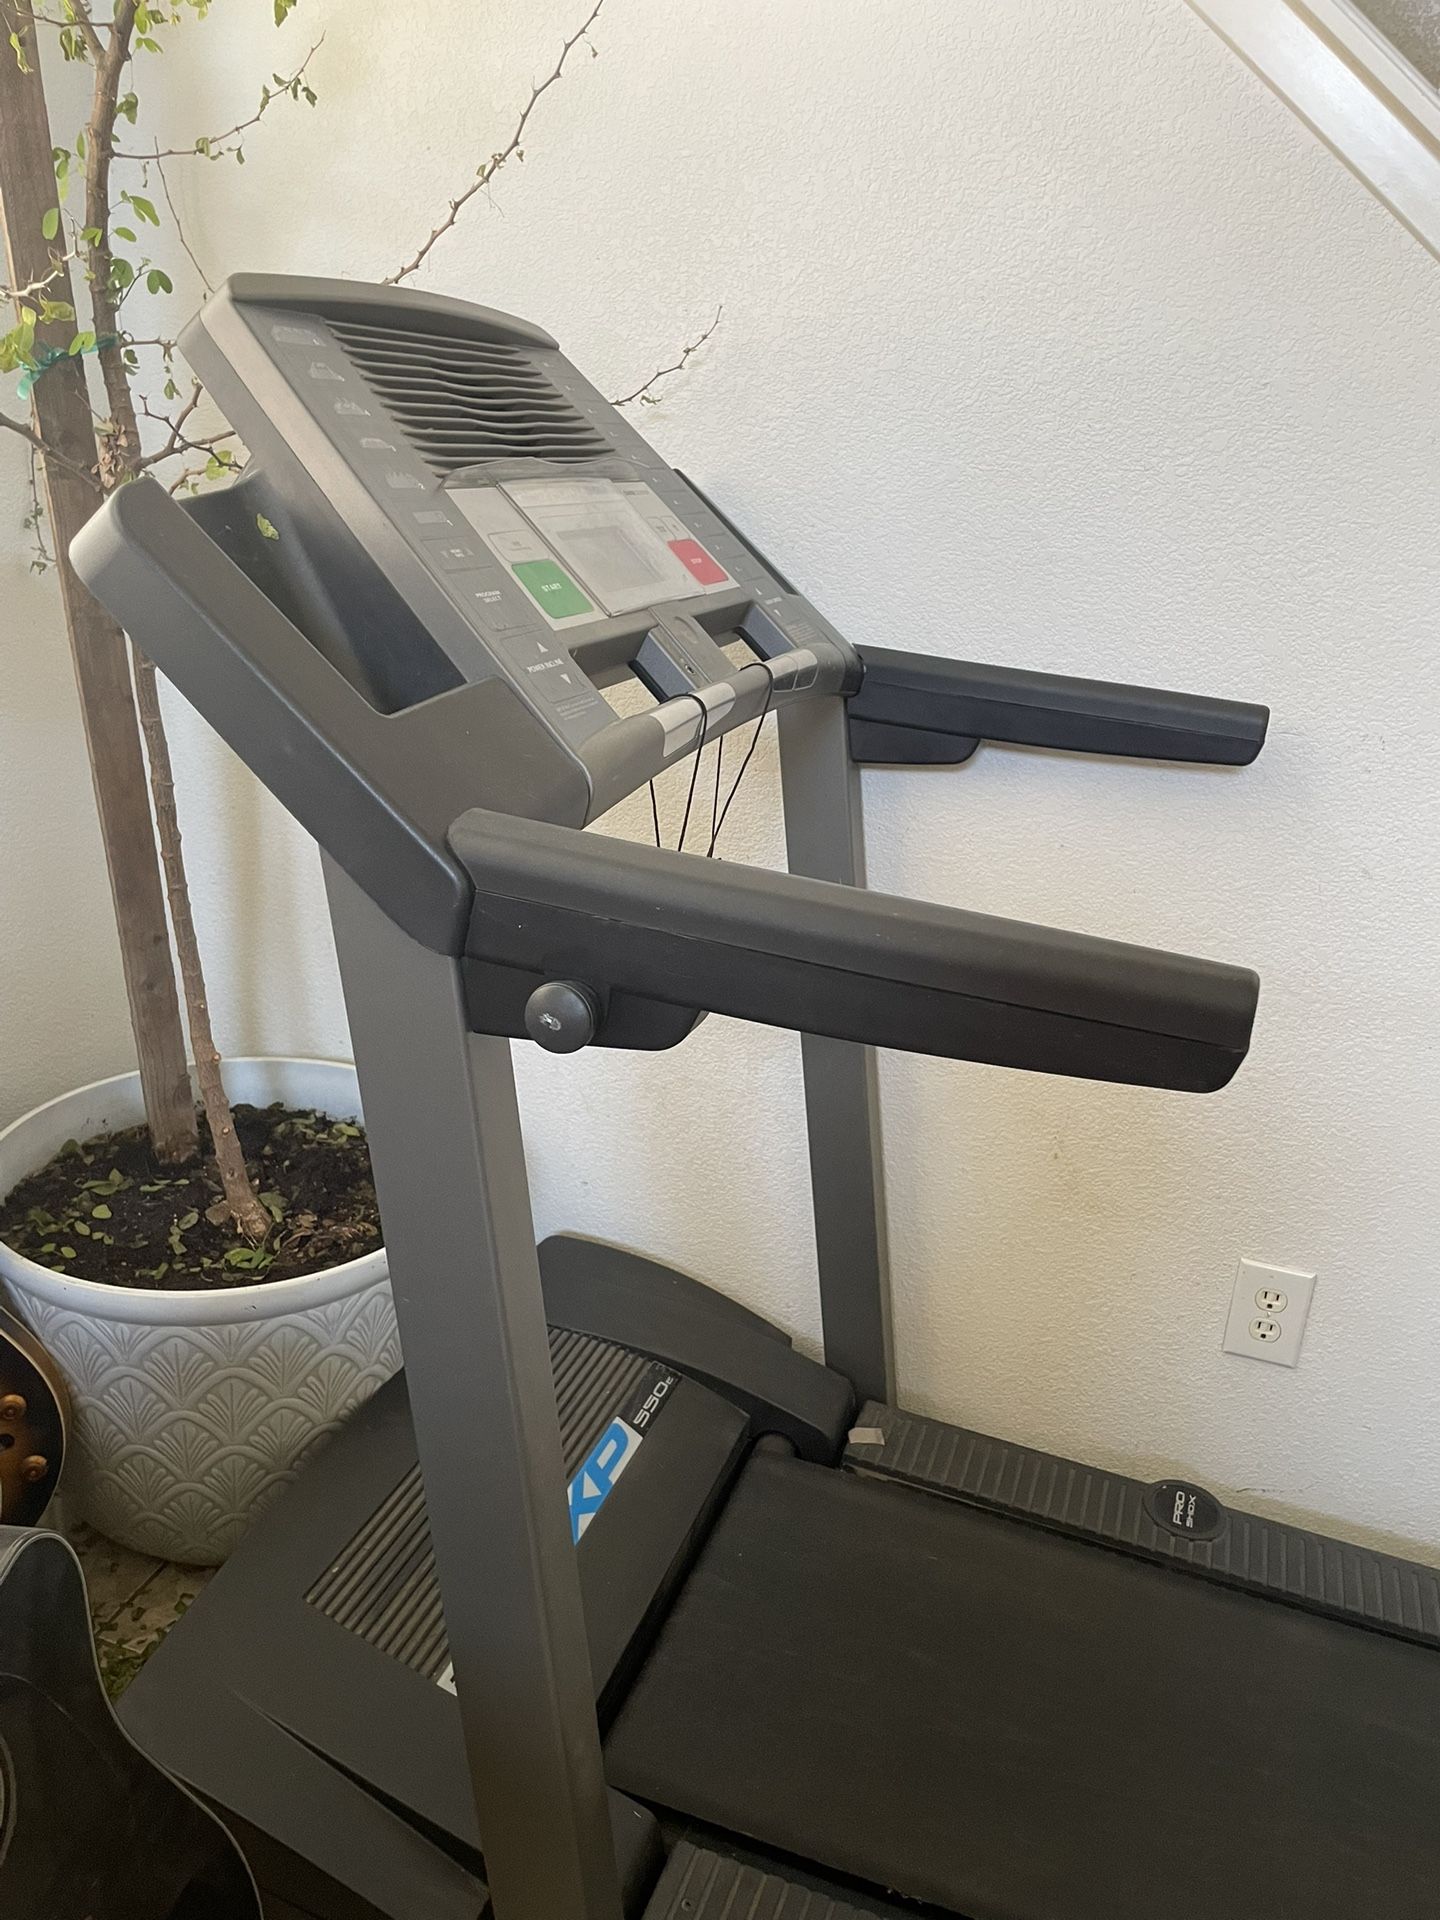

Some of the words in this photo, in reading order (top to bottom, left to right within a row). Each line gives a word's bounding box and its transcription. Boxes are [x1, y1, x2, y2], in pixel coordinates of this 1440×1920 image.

[541, 582, 562, 592] START
[1172, 1491, 1185, 1525] PRO
[1186, 1494, 1197, 1528] SHOX
